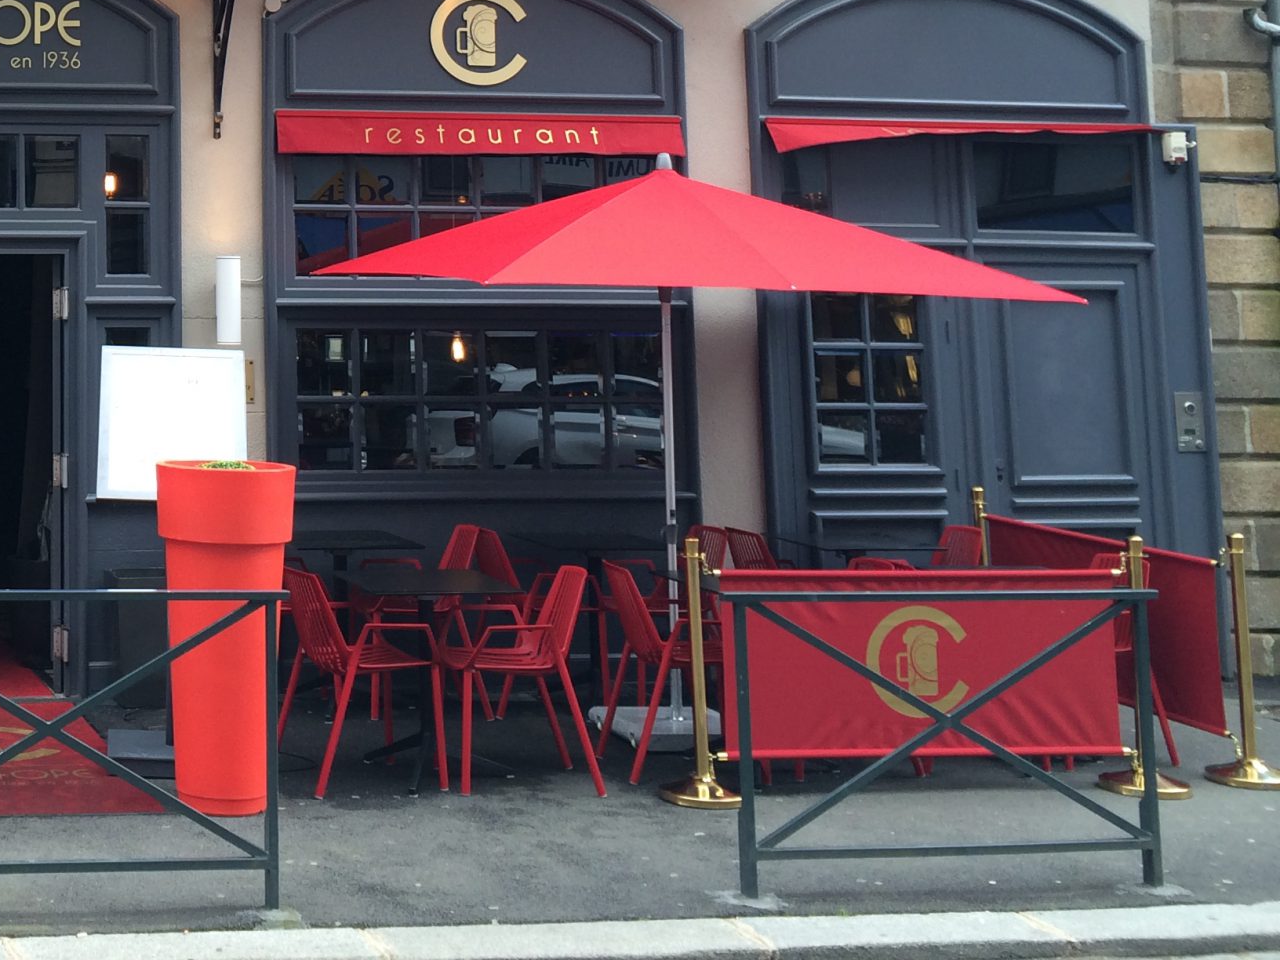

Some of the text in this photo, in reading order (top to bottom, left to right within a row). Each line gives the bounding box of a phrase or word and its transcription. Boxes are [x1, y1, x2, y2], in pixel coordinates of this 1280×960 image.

[10, 55, 32, 68] en
[42, 50, 81, 69] 1936
[364, 124, 600, 146] restaurant
